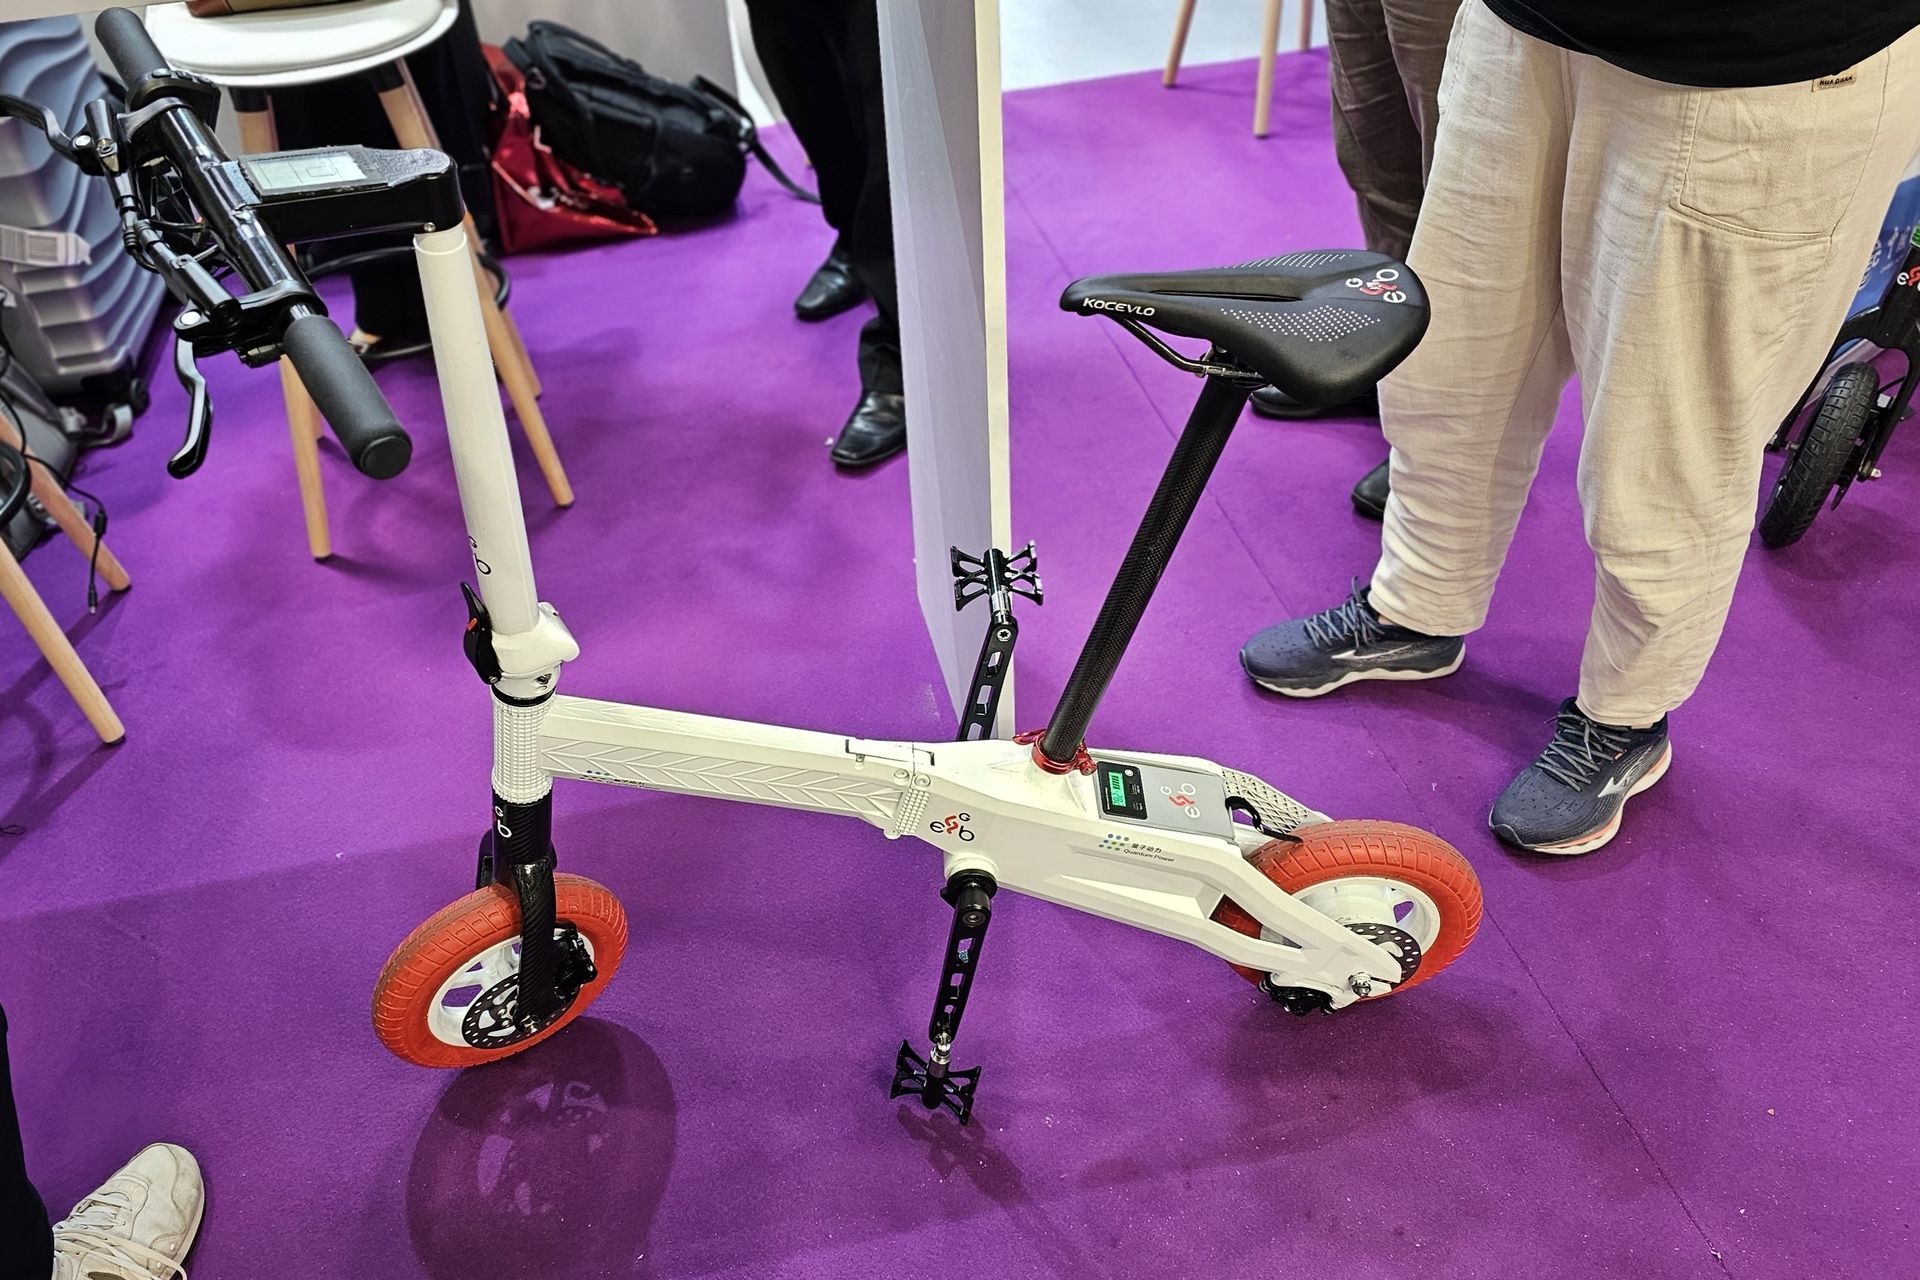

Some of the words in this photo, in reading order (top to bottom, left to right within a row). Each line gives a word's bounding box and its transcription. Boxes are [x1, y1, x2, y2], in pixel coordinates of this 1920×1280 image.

[1082, 297, 1156, 317] KOCEVLO
[1123, 848, 1153, 859] Quantum
[1153, 854, 1175, 863] Power
